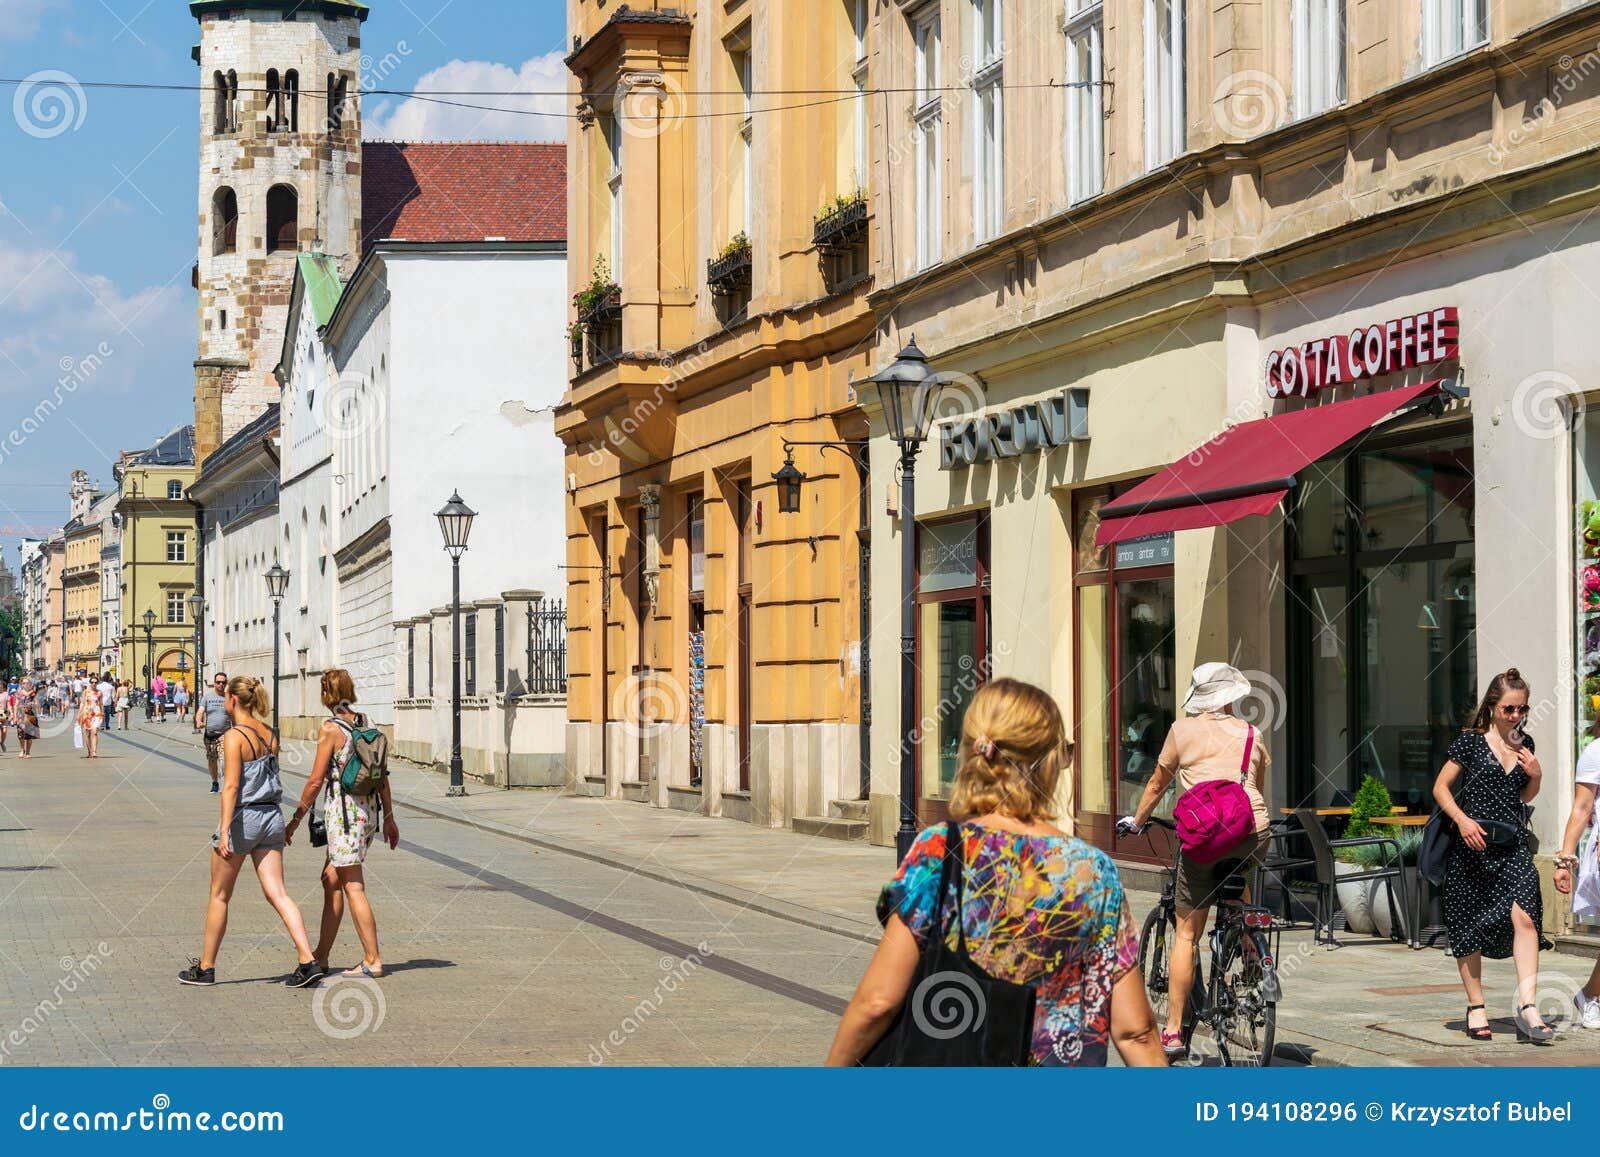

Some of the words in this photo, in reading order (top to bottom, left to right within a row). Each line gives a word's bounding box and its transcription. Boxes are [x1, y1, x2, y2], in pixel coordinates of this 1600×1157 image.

[1264, 335, 1355, 398] COSTA
[1348, 307, 1459, 379] COFFEE
[938, 387, 1091, 471] BORUNI
